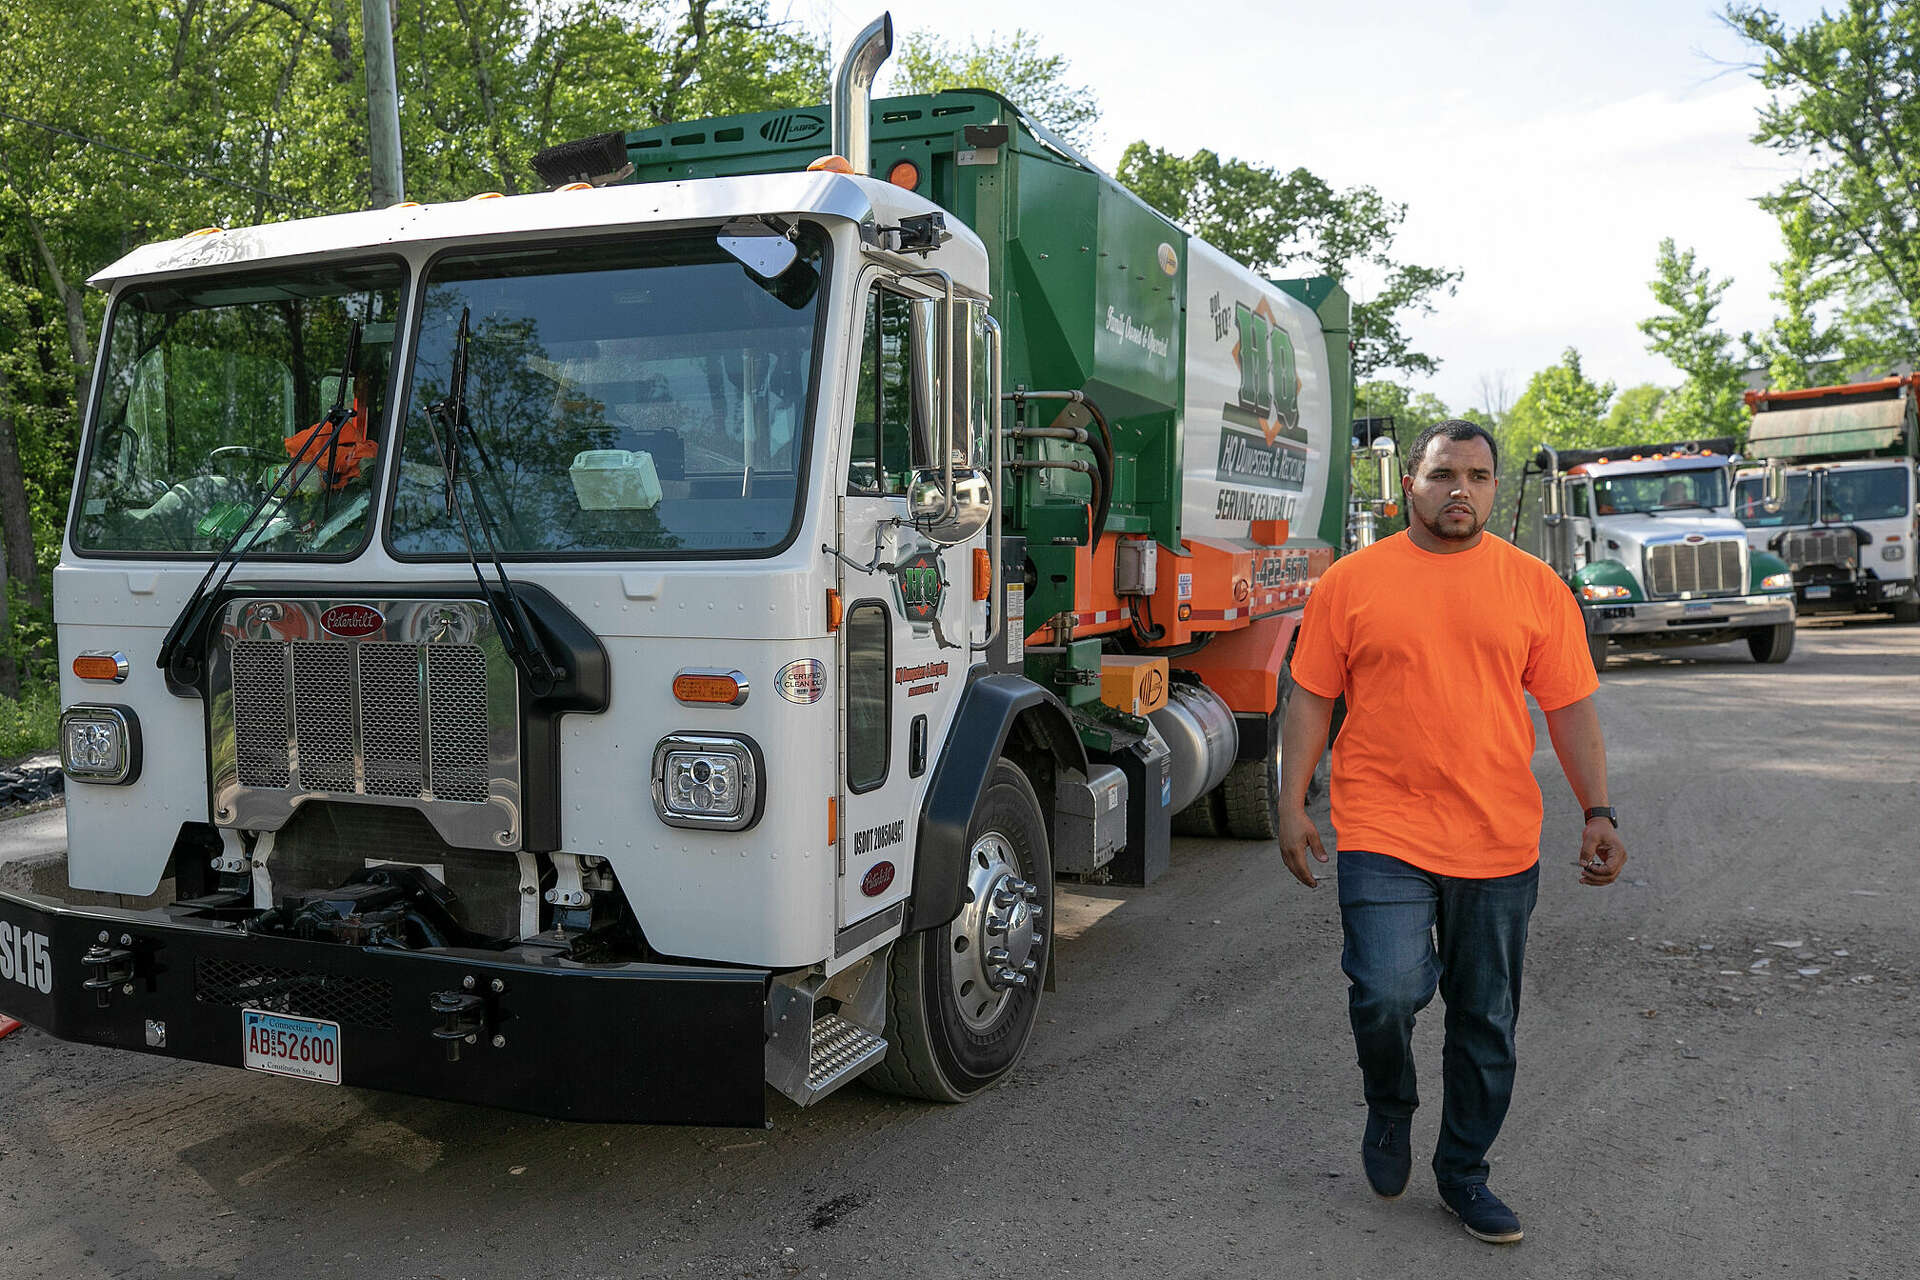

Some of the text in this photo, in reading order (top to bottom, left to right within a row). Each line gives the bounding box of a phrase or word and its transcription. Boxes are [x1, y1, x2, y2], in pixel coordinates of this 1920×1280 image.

[1235, 300, 1299, 430] HQ
[1221, 434, 1238, 477] HQ
[1216, 488, 1255, 520] SERVING
[905, 567, 938, 607] HQ
[326, 609, 378, 629] Peterbilt
[854, 828, 874, 856] USDOT
[0, 920, 52, 994] SL15
[269, 1019, 313, 1033] Connecticut
[267, 1061, 317, 1077] Constitution State
